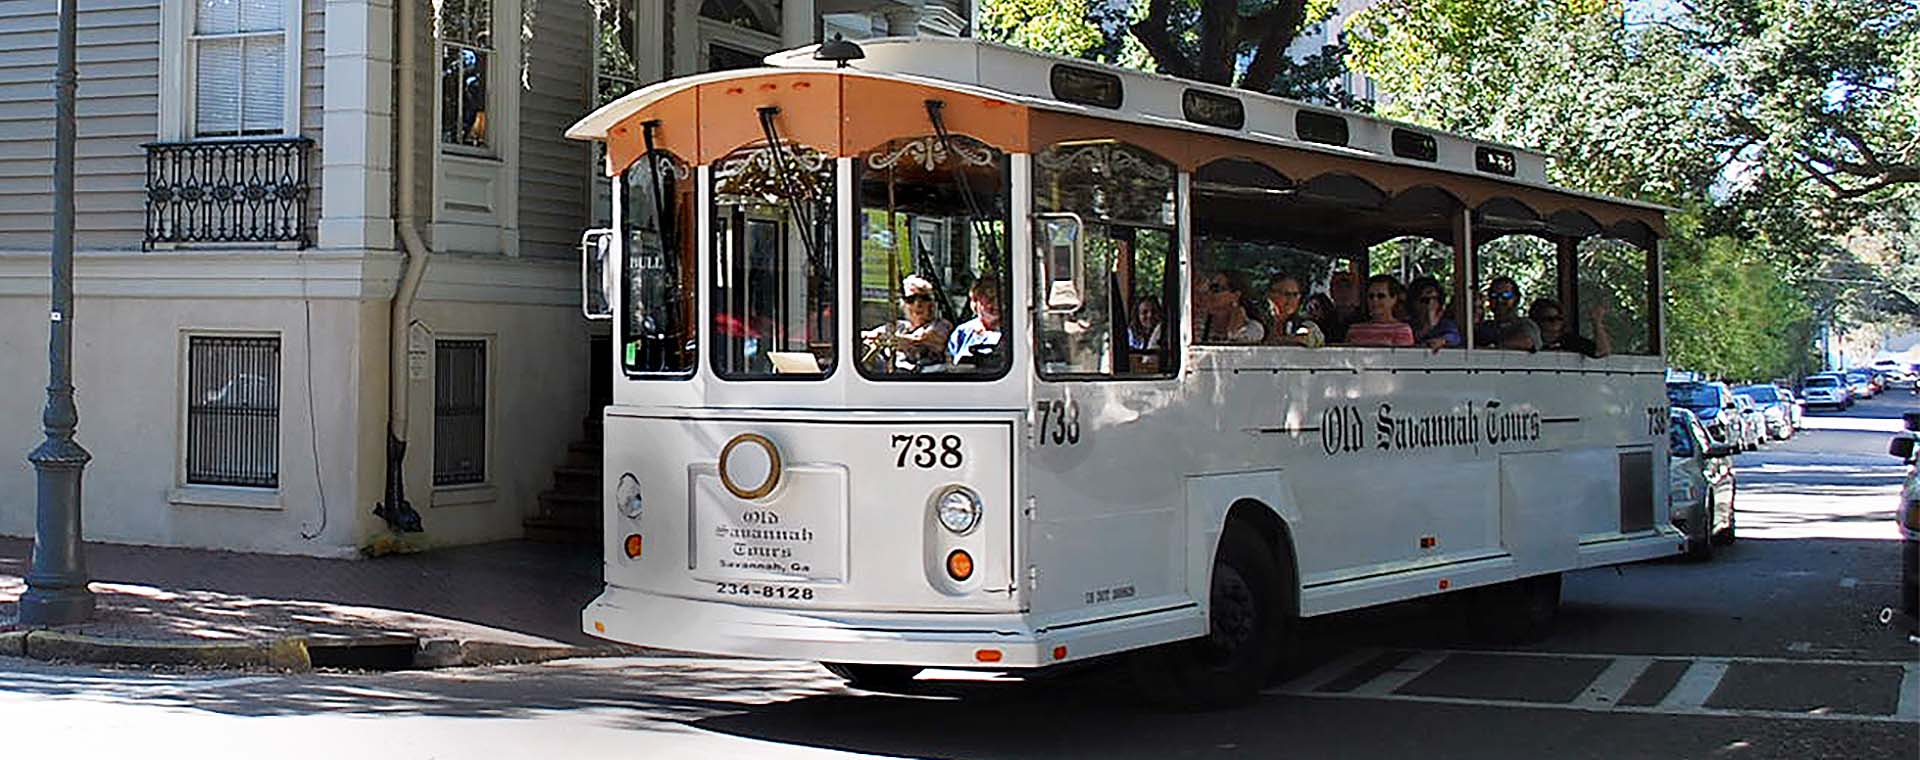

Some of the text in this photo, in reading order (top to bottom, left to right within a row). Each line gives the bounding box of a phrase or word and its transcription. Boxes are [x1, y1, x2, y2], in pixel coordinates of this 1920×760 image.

[630, 255, 664, 269] BULL
[1036, 400, 1080, 445] 738
[1322, 400, 1540, 456] Old Savannah Tours
[891, 434, 963, 468] 738
[743, 511, 778, 524] Old
[716, 526, 813, 541] Savannah
[733, 543, 791, 558] Tours
[716, 582, 813, 600] 234-8128
